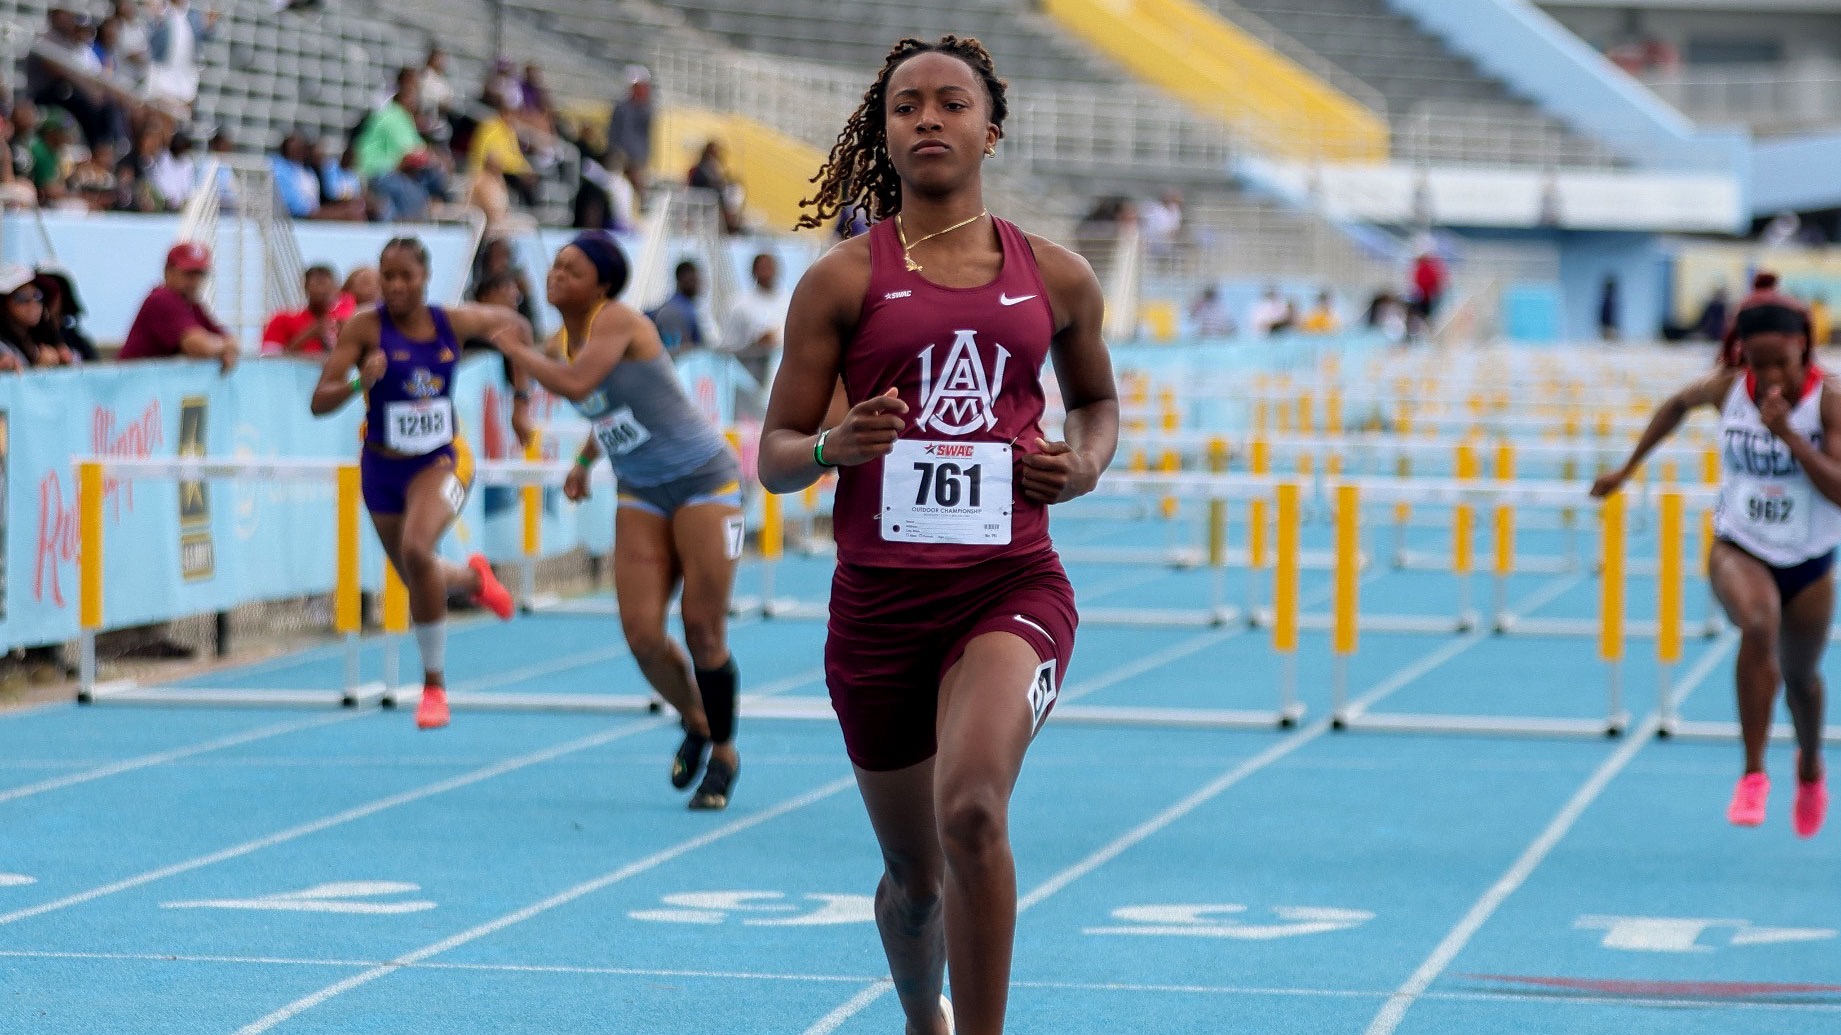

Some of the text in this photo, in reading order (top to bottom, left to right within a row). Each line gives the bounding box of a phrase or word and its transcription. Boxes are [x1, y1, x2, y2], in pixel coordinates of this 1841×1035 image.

[891, 290, 912, 299] SWAC
[398, 416, 445, 436] 1293
[936, 445, 974, 457] SWAC
[914, 463, 982, 507] 761
[911, 506, 939, 514] OUTDOOR
[1749, 497, 1793, 522] 962
[160, 881, 438, 913] 7
[1083, 904, 1375, 940] 5
[1574, 914, 1837, 952] 4
